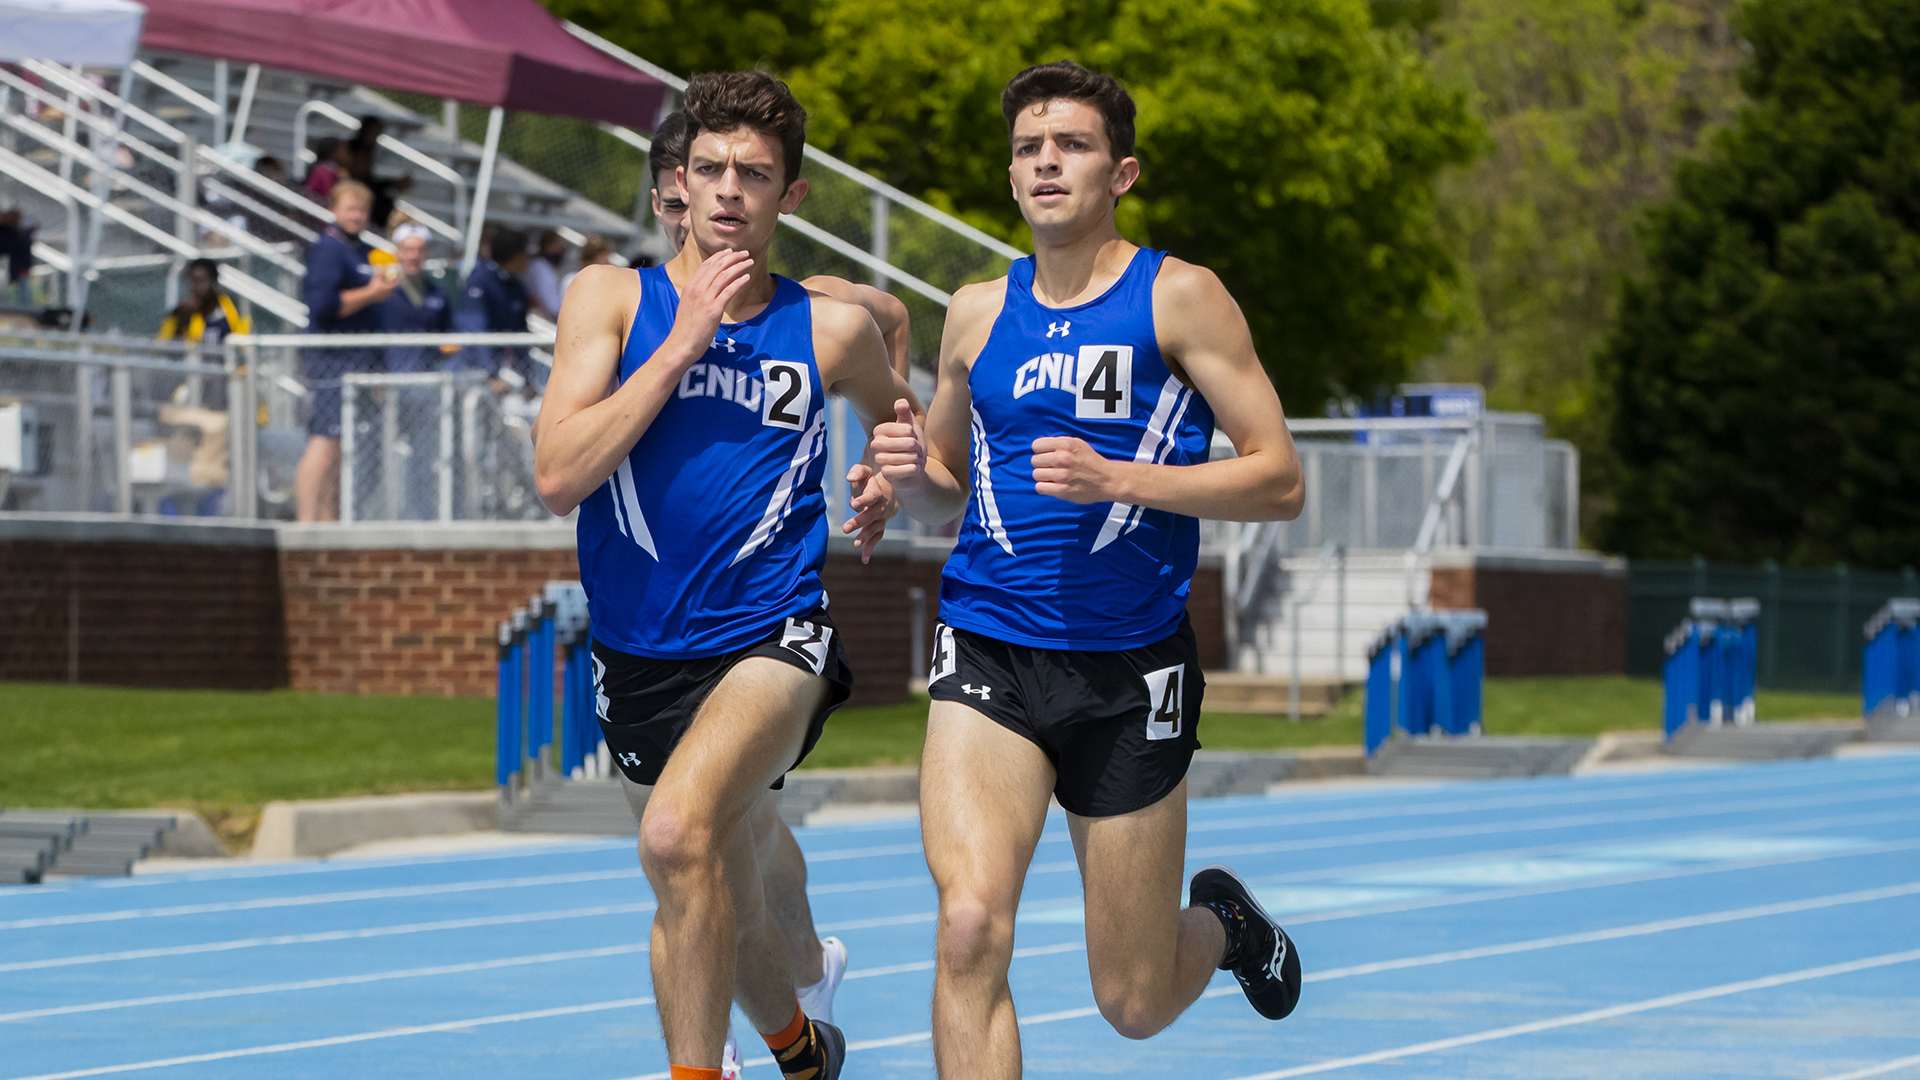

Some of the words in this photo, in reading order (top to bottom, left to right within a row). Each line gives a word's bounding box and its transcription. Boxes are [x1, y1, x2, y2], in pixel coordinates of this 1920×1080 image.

[678, 363, 765, 413] CNU
[769, 365, 802, 425] 2
[1082, 351, 1123, 413] 4
[786, 619, 824, 667] 2
[1154, 671, 1180, 733] 4
